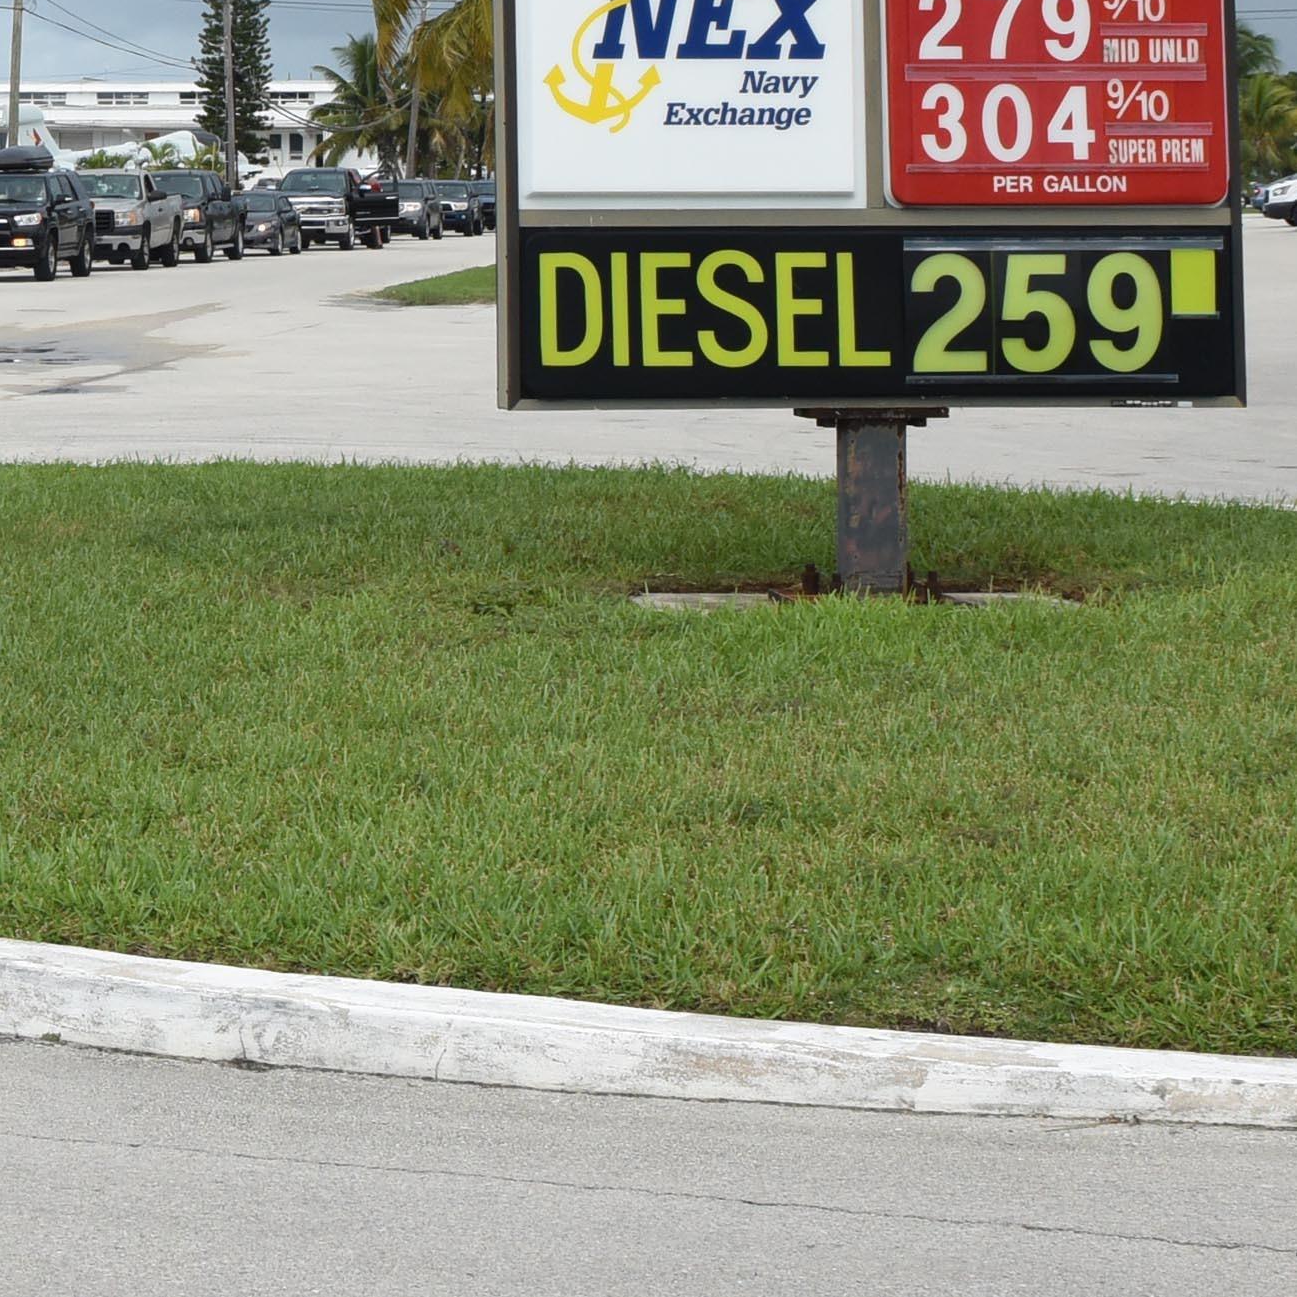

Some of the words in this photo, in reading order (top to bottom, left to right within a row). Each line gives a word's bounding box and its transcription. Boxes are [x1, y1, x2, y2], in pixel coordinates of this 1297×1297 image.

[1103, 38, 1140, 63] MID
[1148, 38, 1199, 64] UNLD
[739, 70, 819, 98] Navy
[663, 101, 813, 130] Exchange
[921, 82, 1096, 163] 304
[1107, 78, 1170, 122] 9/10
[1108, 138, 1157, 164] SUPER
[1162, 138, 1204, 164] PREM
[993, 175, 1033, 193] PER
[1043, 175, 1127, 193] GALLON
[538, 249, 892, 368] DIESEL
[911, 252, 1164, 373] 259
